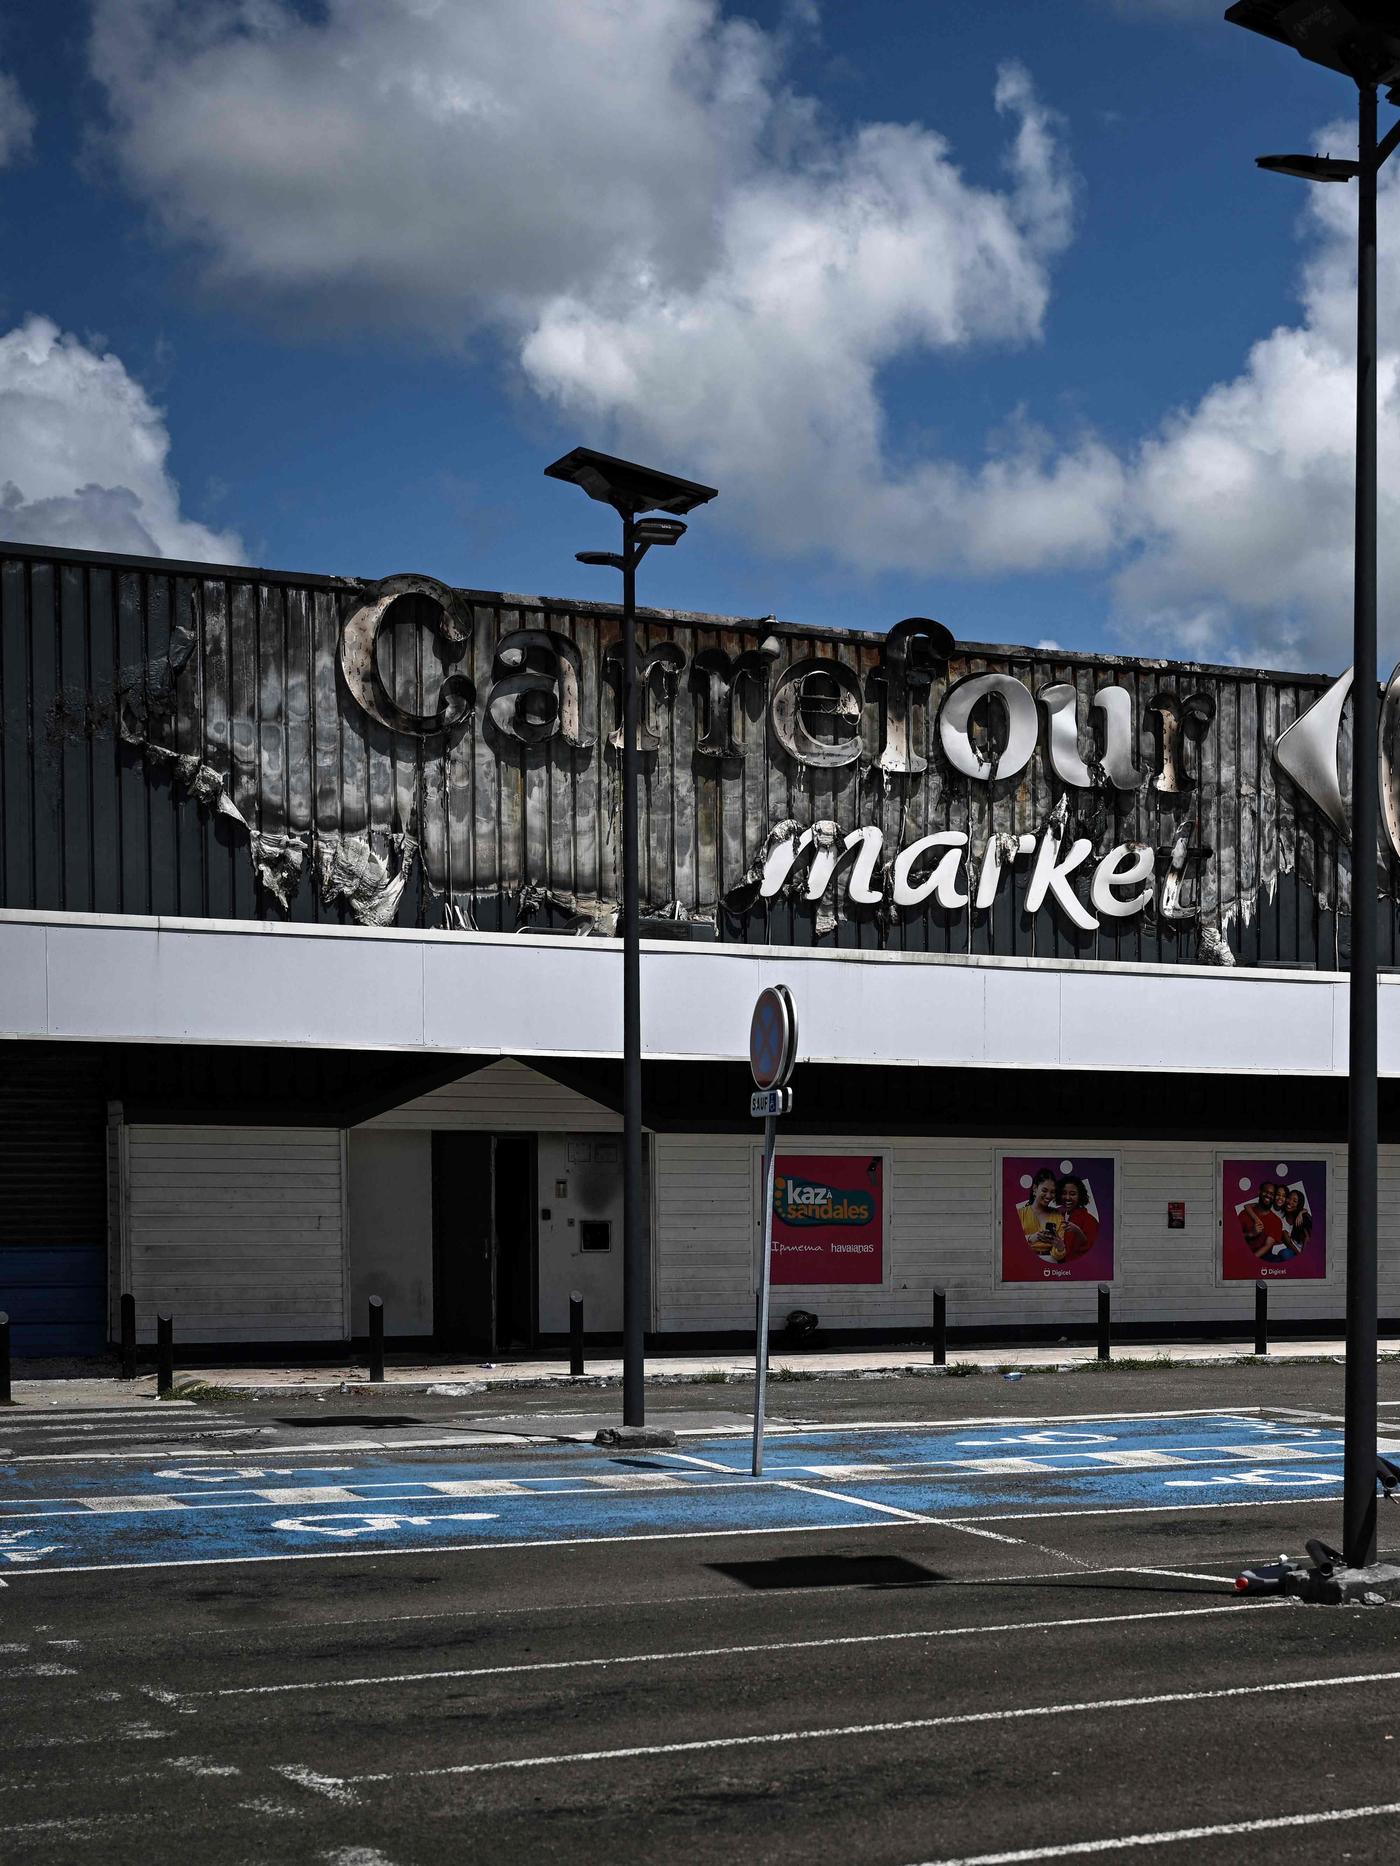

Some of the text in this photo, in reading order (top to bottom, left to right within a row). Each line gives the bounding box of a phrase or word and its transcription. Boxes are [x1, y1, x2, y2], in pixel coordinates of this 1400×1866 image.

[340, 573, 1216, 793] Carrefour
[760, 796, 1212, 930] market
[752, 1096, 768, 1111] SAUF
[787, 1179, 827, 1204] kaz
[787, 1198, 869, 1220] sandales
[771, 1241, 824, 1256] Ipanema
[1051, 1269, 1072, 1278] Digicel
[1268, 1268, 1287, 1277] Digicel
